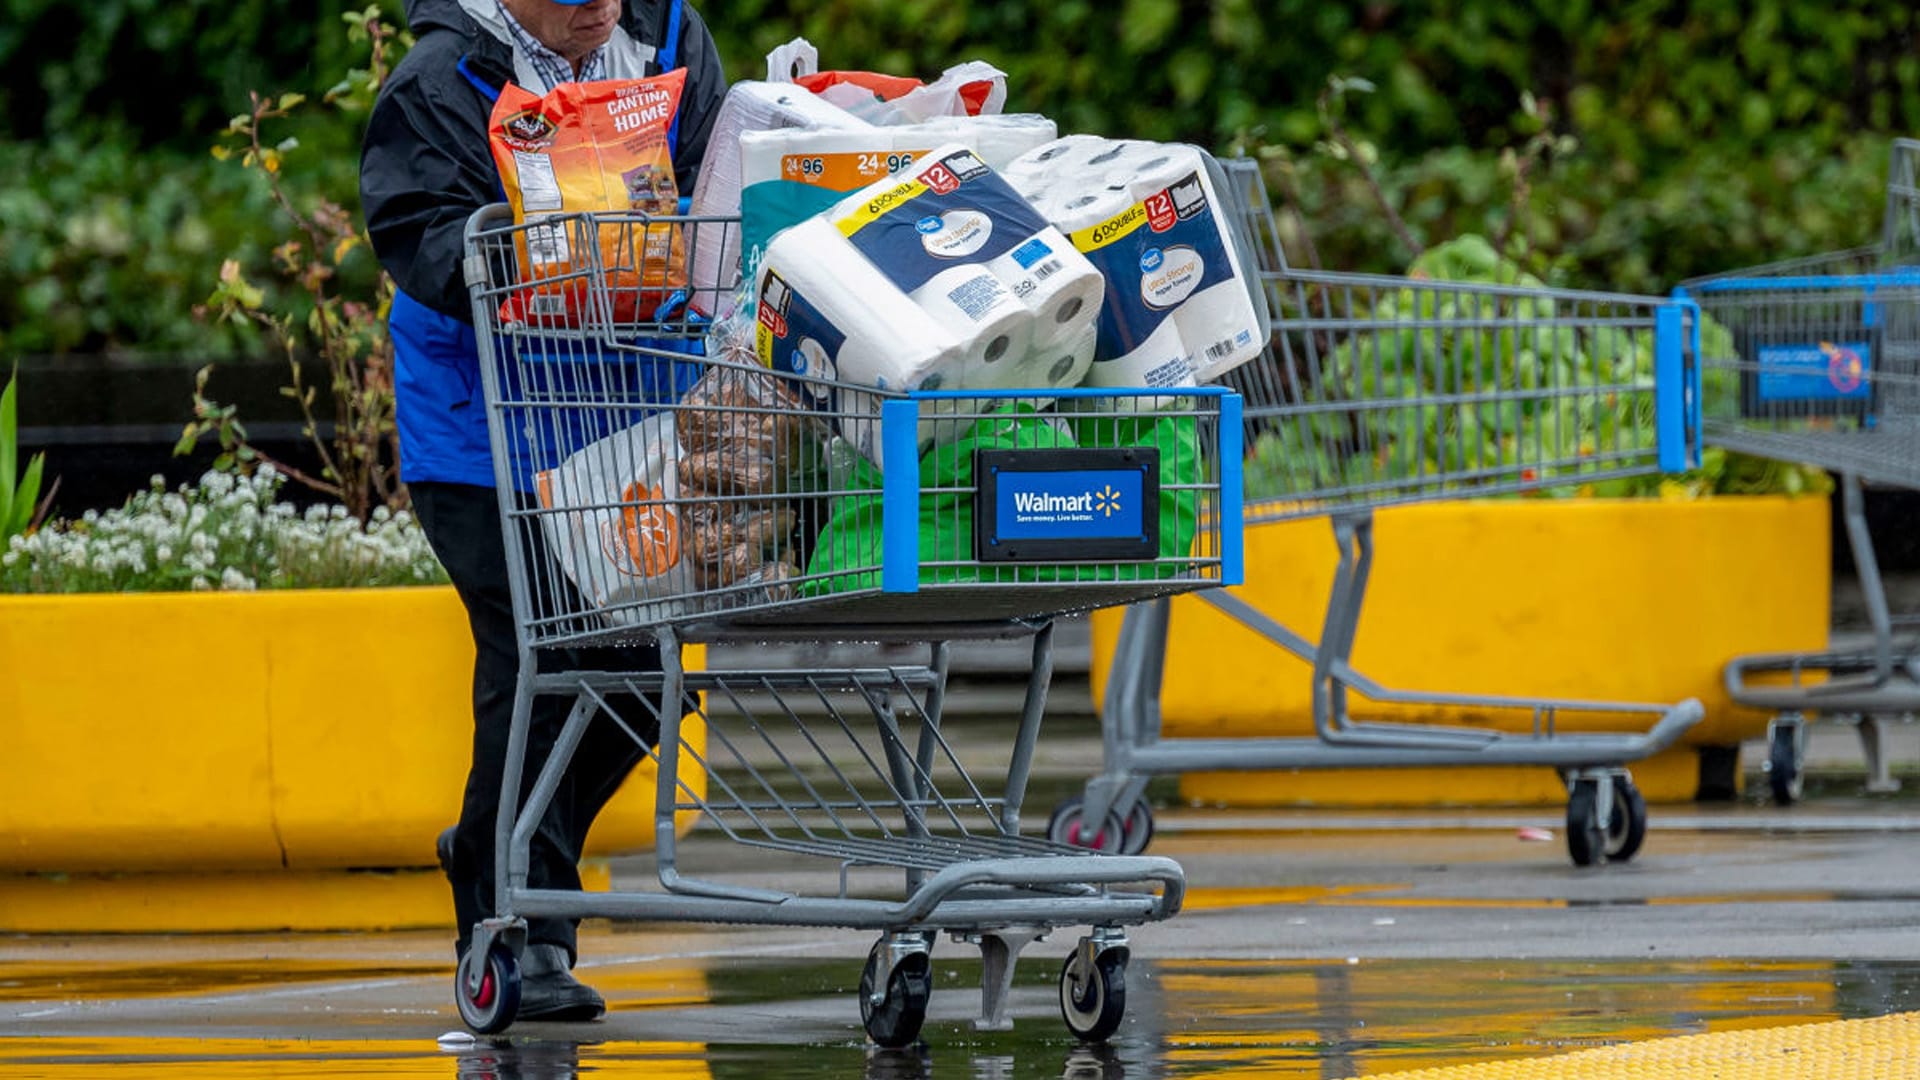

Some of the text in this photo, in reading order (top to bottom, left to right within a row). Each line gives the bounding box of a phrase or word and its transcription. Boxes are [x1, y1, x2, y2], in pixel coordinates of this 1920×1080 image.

[607, 90, 671, 116] CANTINA
[614, 101, 669, 133] HOME
[786, 158, 824, 174] 24 96
[857, 153, 879, 171] 24
[868, 202, 880, 213] 6
[875, 182, 915, 207] DOUBLE
[921, 166, 950, 190] 12
[1092, 230, 1103, 243] 6
[1102, 207, 1137, 235] DOUBLE
[1147, 194, 1171, 217] 12
[1014, 491, 1093, 512] Walmart
[1016, 514, 1032, 522] Save
[1032, 515, 1056, 523] money.
[1071, 513, 1094, 521] better.
